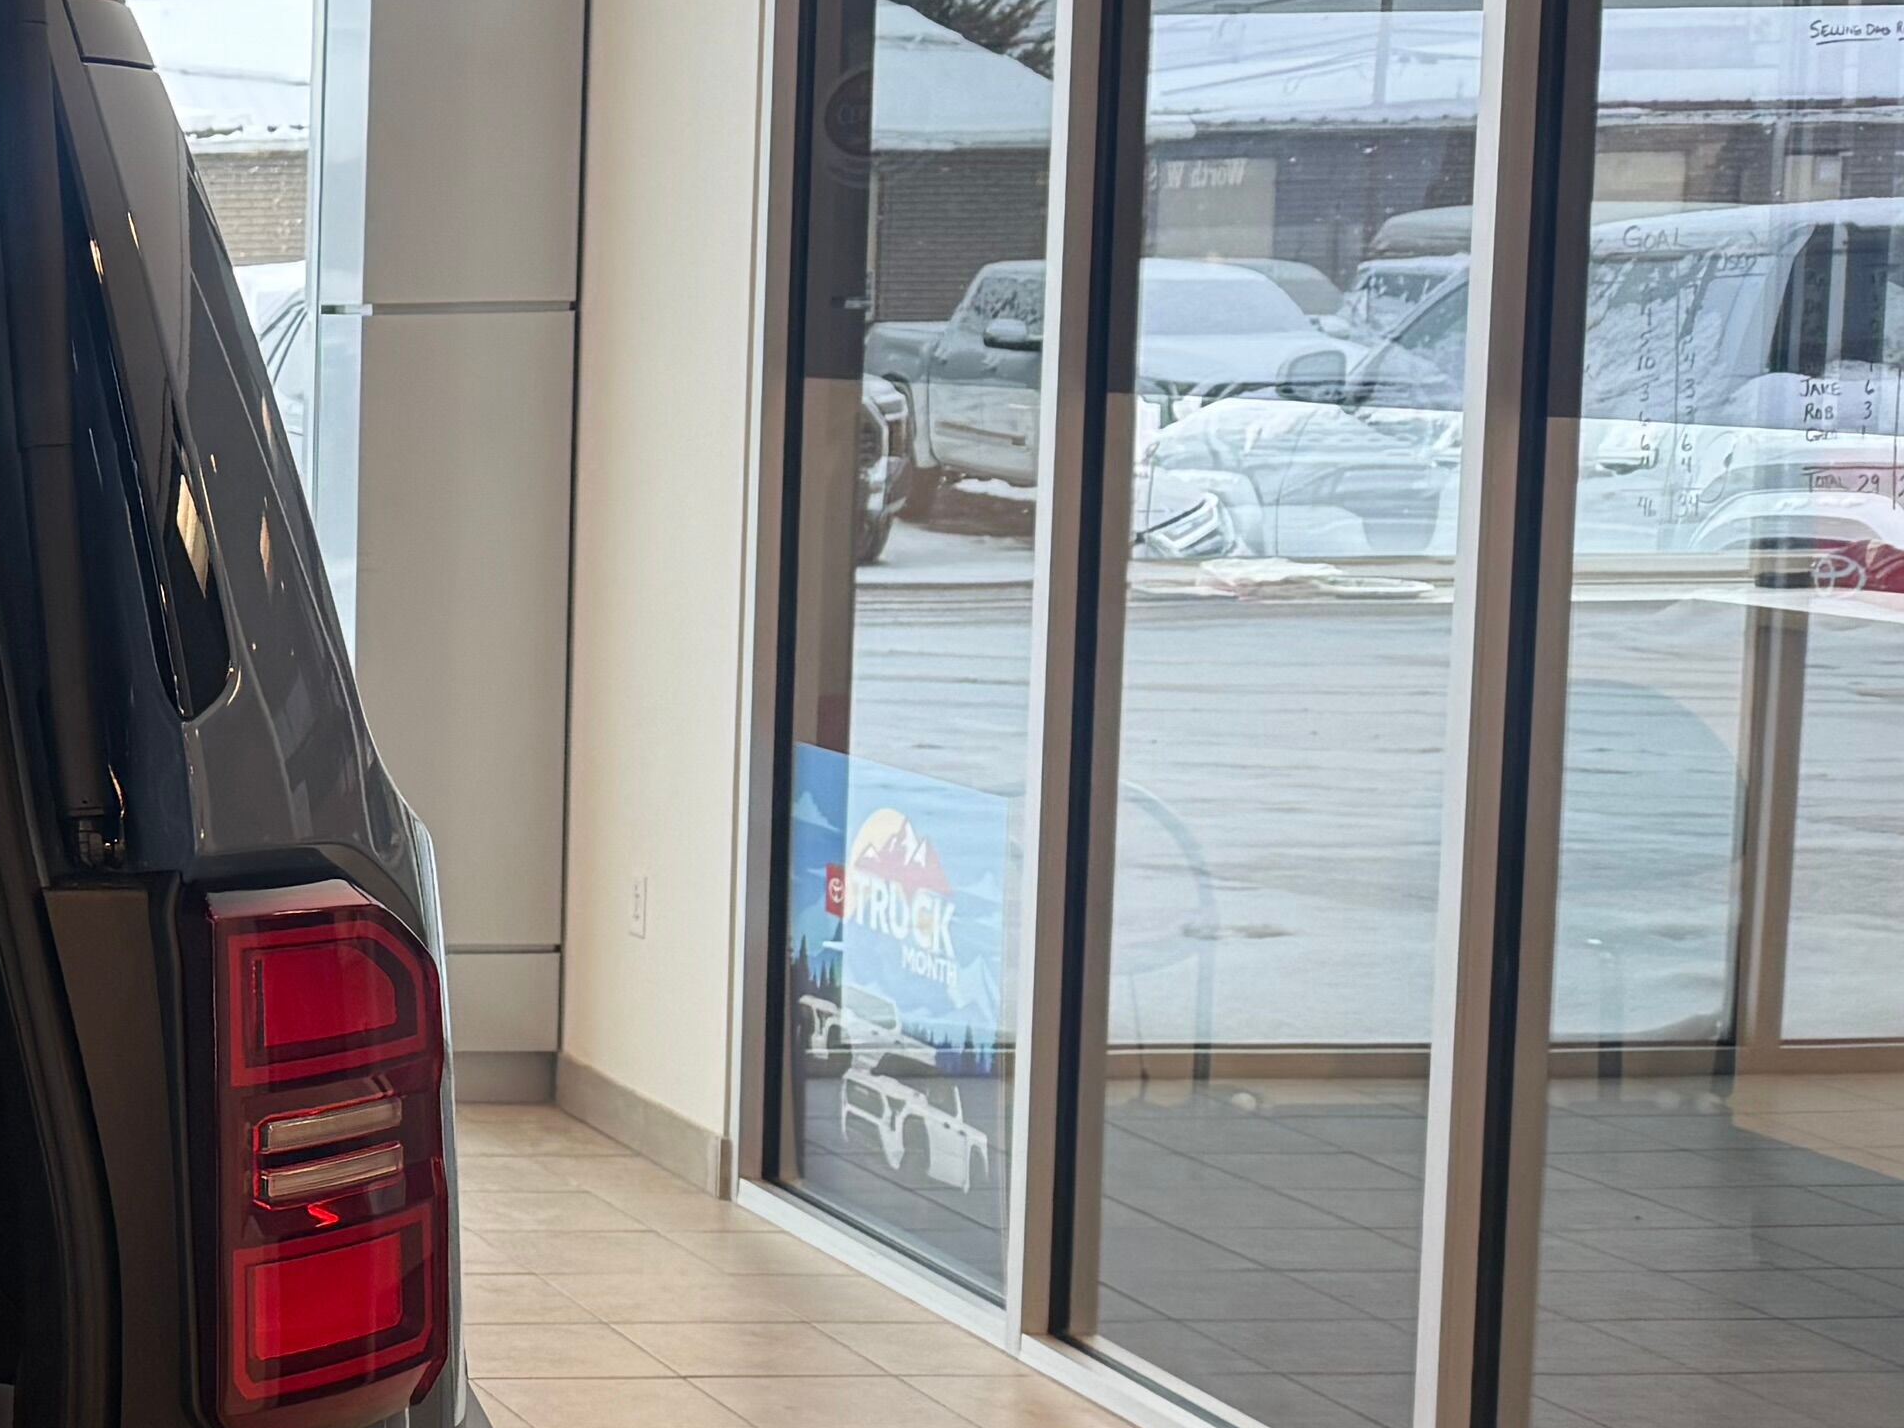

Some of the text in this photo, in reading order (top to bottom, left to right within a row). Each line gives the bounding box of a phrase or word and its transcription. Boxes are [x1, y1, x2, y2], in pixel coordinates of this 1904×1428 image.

[1622, 225, 1690, 250] GOAL
[1800, 379, 1842, 398] JAKE
[1681, 433, 1693, 452] 6
[1857, 474, 1881, 494] 29
[852, 875, 956, 960] TRUCK
[901, 945, 958, 987] MONTH
